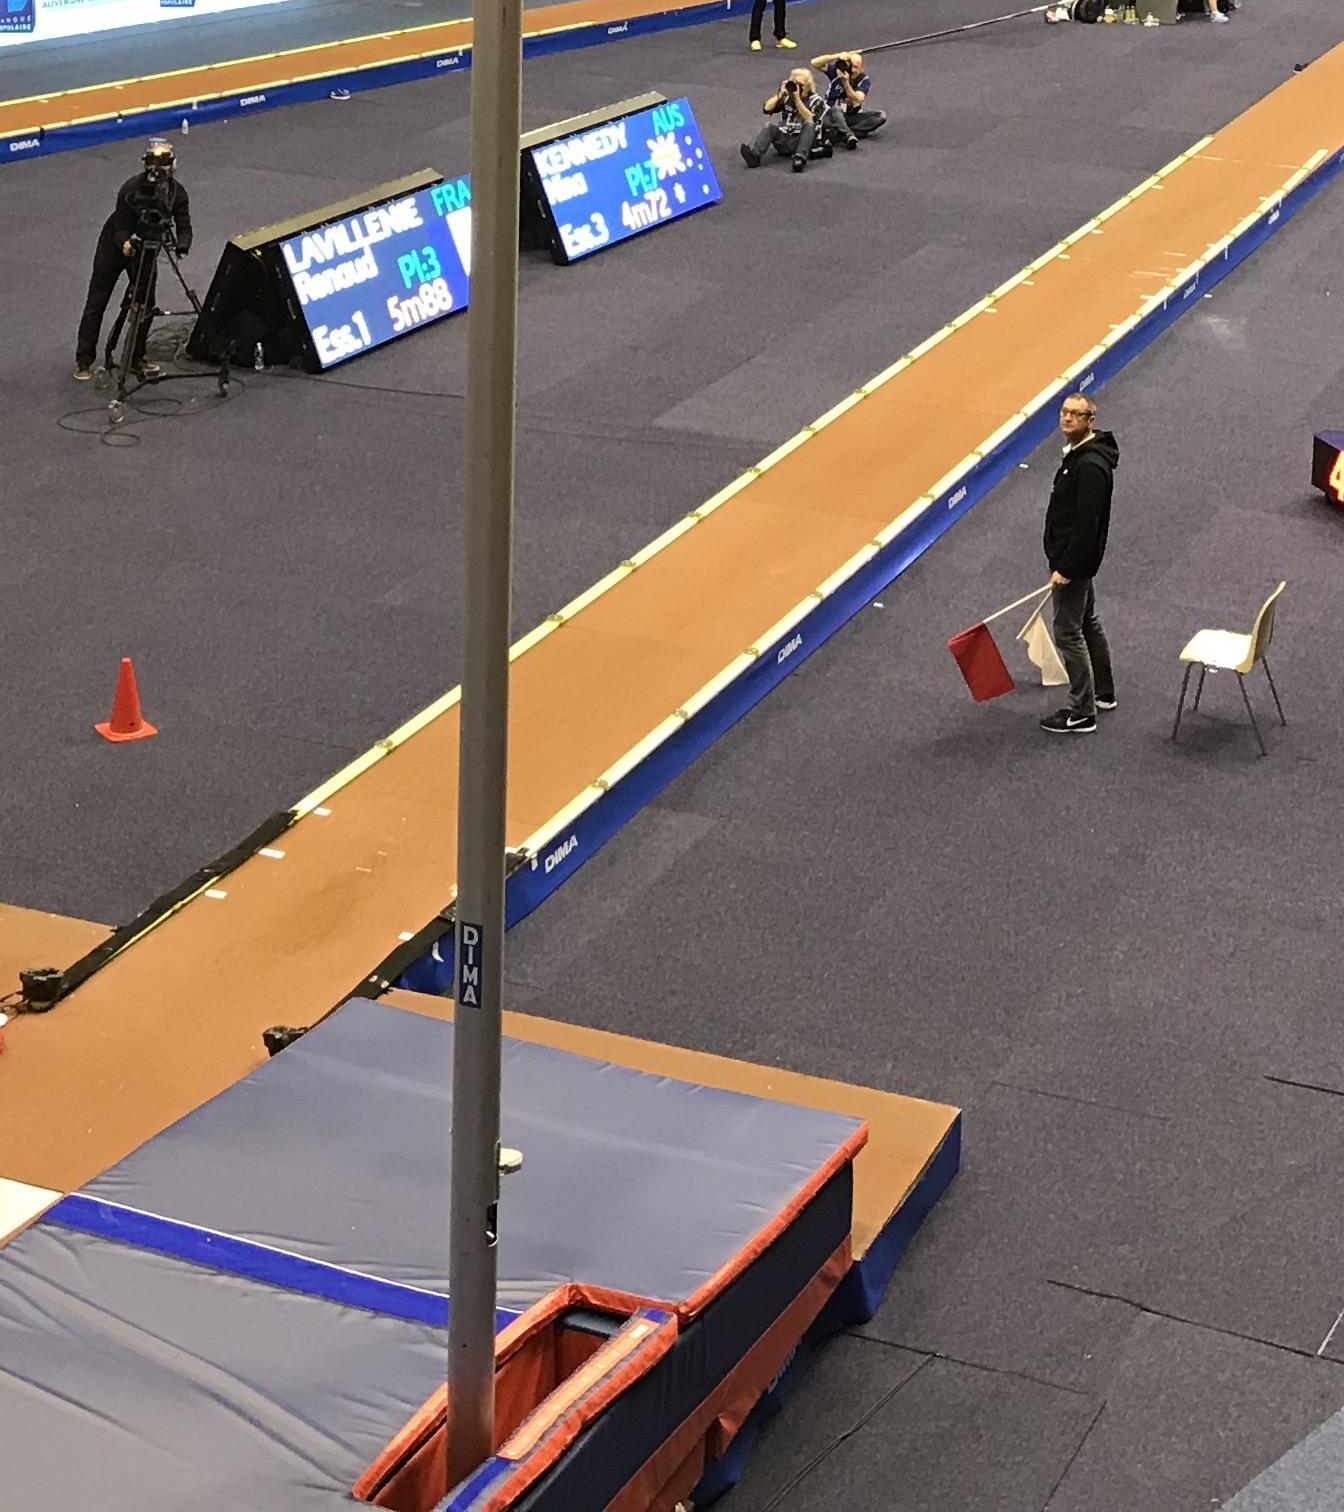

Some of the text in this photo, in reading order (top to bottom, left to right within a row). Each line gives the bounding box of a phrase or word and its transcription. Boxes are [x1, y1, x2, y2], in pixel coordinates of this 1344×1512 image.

[437, 57, 459, 68] DIMA
[240, 94, 266, 107] DIMA
[10, 138, 40, 152] DIMA
[534, 104, 685, 177] KENNEDY AUS
[430, 179, 471, 216] FRA
[621, 188, 672, 230] 4m72
[292, 244, 379, 305] Renaud
[387, 277, 453, 332] 5m88
[545, 834, 579, 873] DIMA
[463, 925, 479, 1004] DIMA
